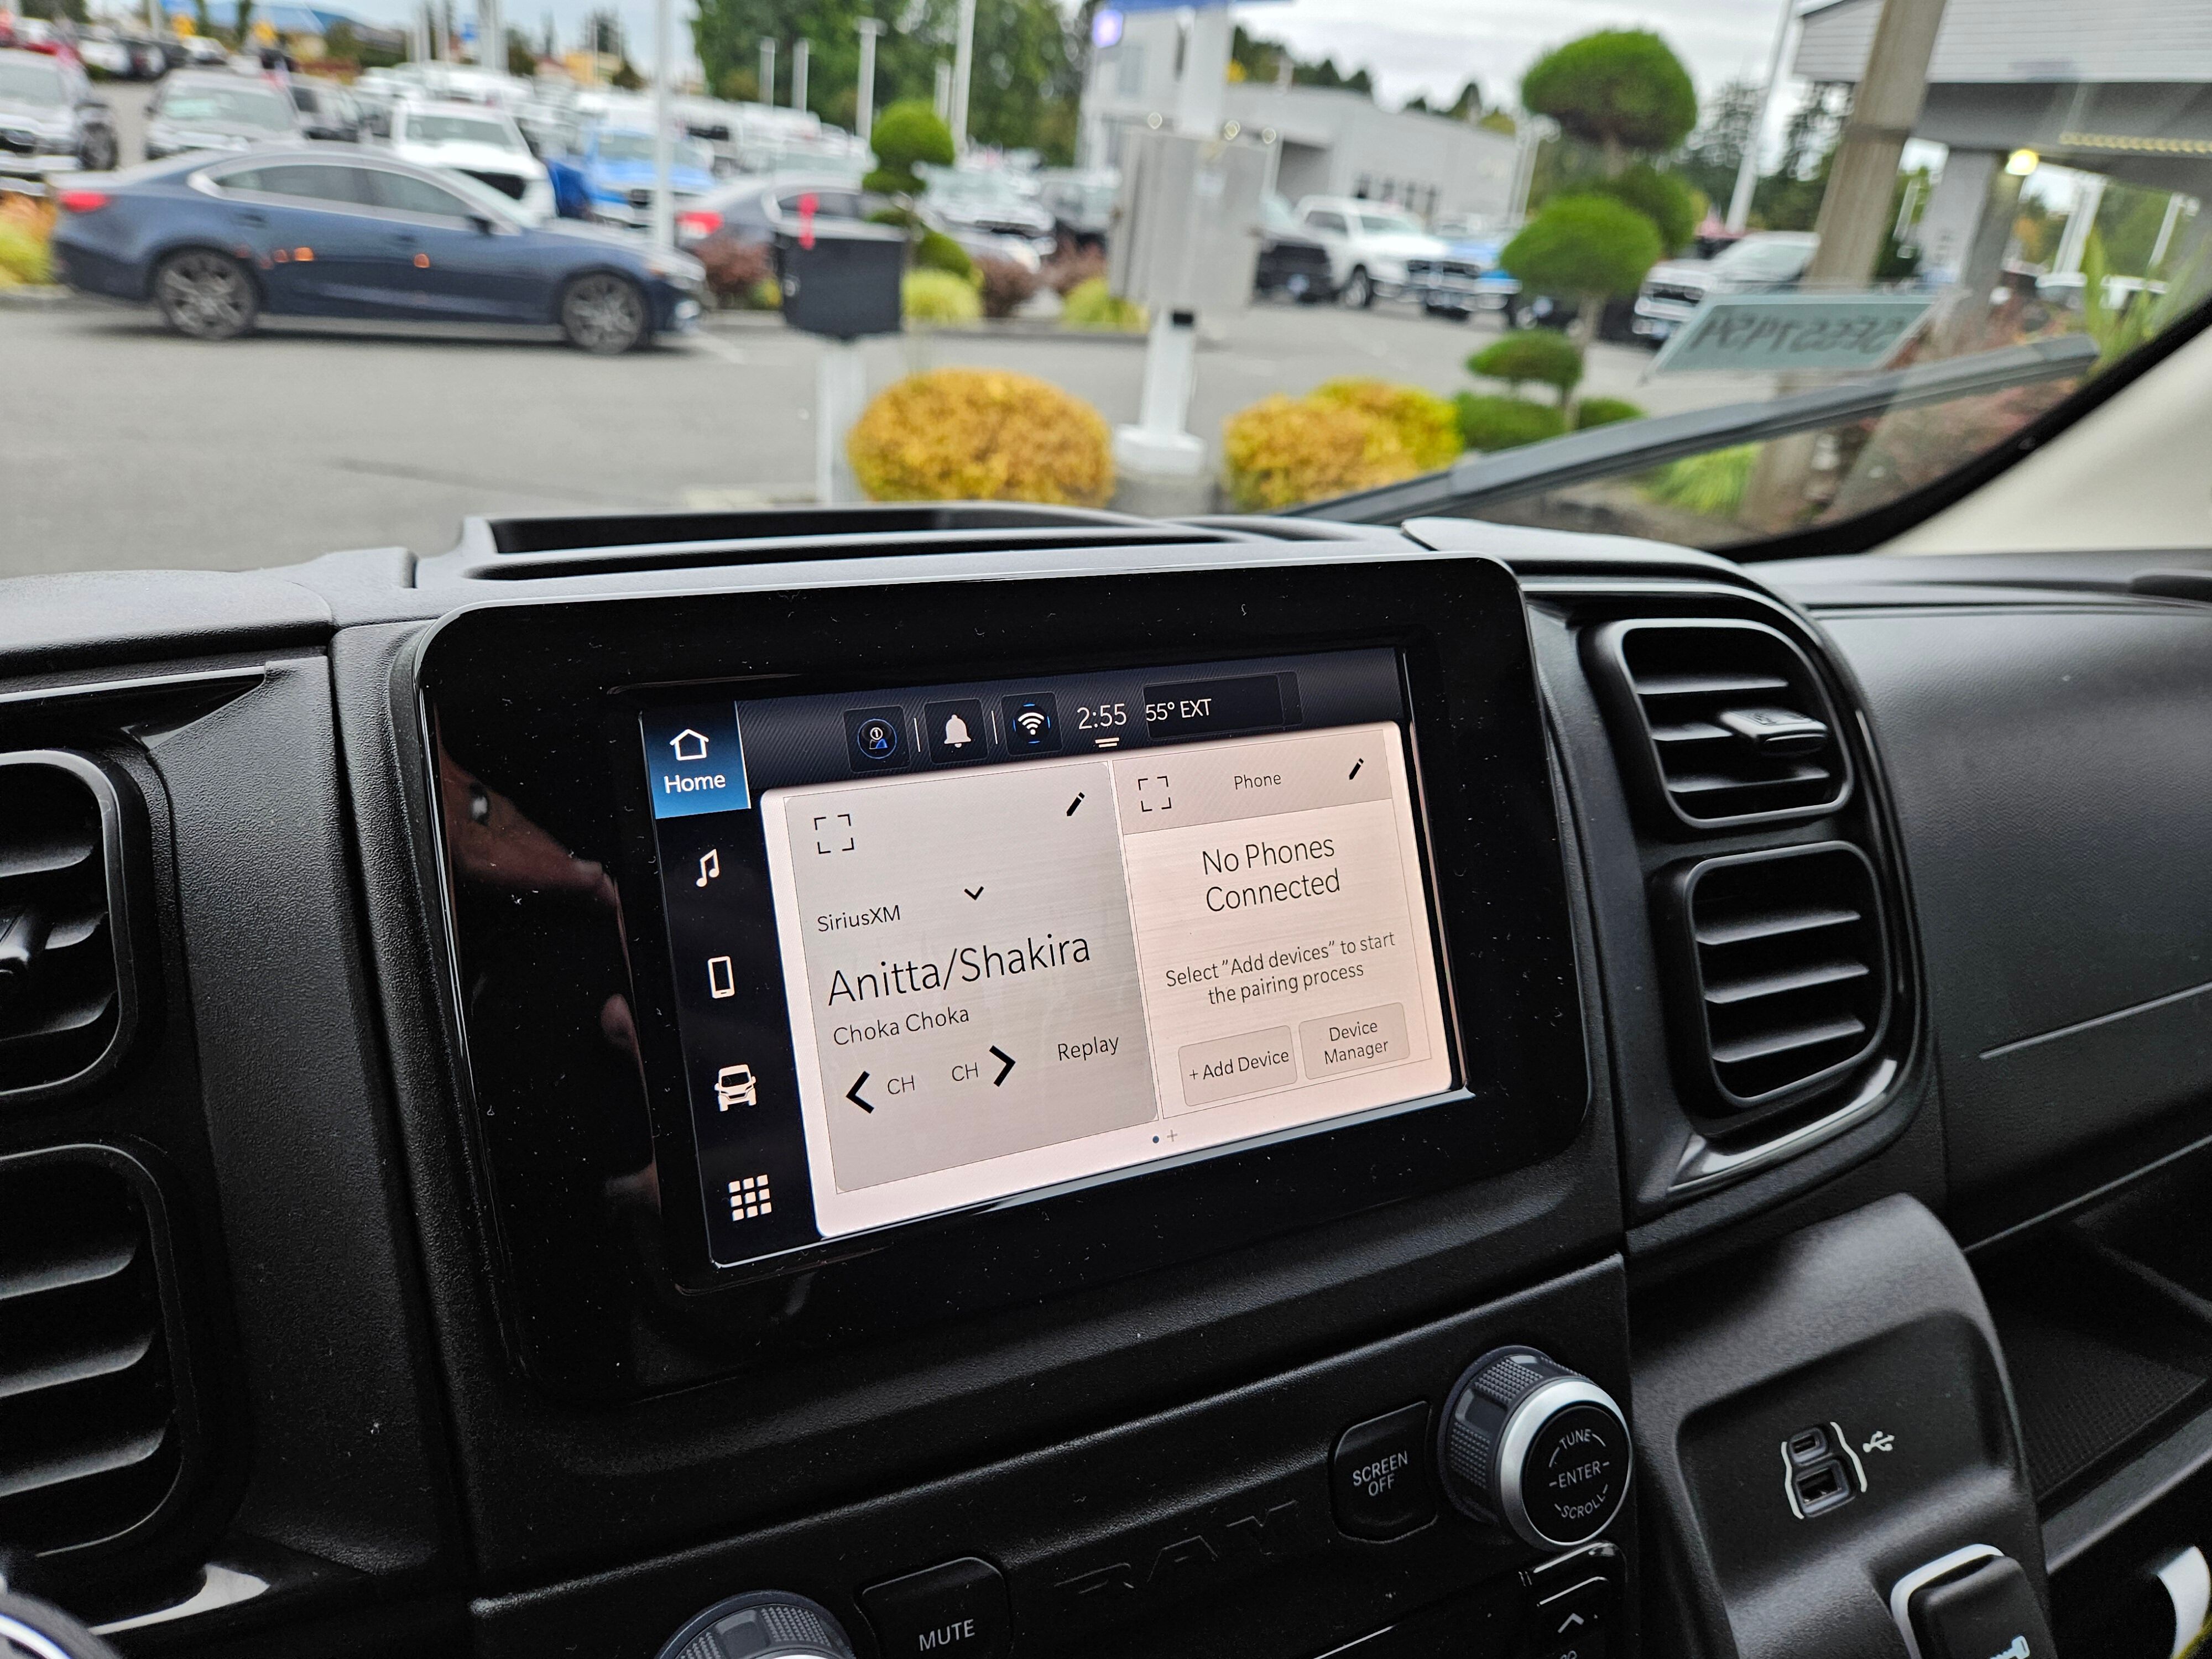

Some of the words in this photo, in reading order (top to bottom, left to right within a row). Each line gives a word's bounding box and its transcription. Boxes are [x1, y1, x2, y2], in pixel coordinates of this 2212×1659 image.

[1077, 703, 1126, 729] 2:55
[1180, 698, 1212, 718] EXT
[664, 775, 726, 794] Home
[1234, 774, 1281, 790] Phone
[1202, 849, 1239, 875] No
[1245, 839, 1335, 868] Phones
[1206, 868, 1340, 912] Connected
[817, 905, 900, 932] SiriusXM
[828, 933, 1091, 1006] Anitta/Shakira
[1166, 963, 1219, 987] Select
[1340, 941, 1356, 954] to
[1360, 932, 1395, 952] start
[1208, 987, 1237, 1005] the
[1240, 975, 1298, 1003] pairing
[1303, 963, 1364, 991] process
[833, 1019, 900, 1045] Choka
[906, 1006, 969, 1032] Choka
[1329, 1022, 1378, 1042] Device
[1058, 1036, 1119, 1061] Replay
[1324, 1039, 1389, 1065] Manager
[952, 1062, 978, 1082] CH
[1203, 1058, 1234, 1080] Add
[1238, 1051, 1289, 1072] Device
[887, 1075, 915, 1095] CH
[1559, 1428, 1592, 1451] TUNE
[1353, 1451, 1408, 1487] SCREEN
[1558, 1460, 1601, 1488] ENTER
[1368, 1474, 1395, 1496] OFF
[1561, 1494, 1605, 1520] SCROLL
[919, 1619, 975, 1651] MUTE
